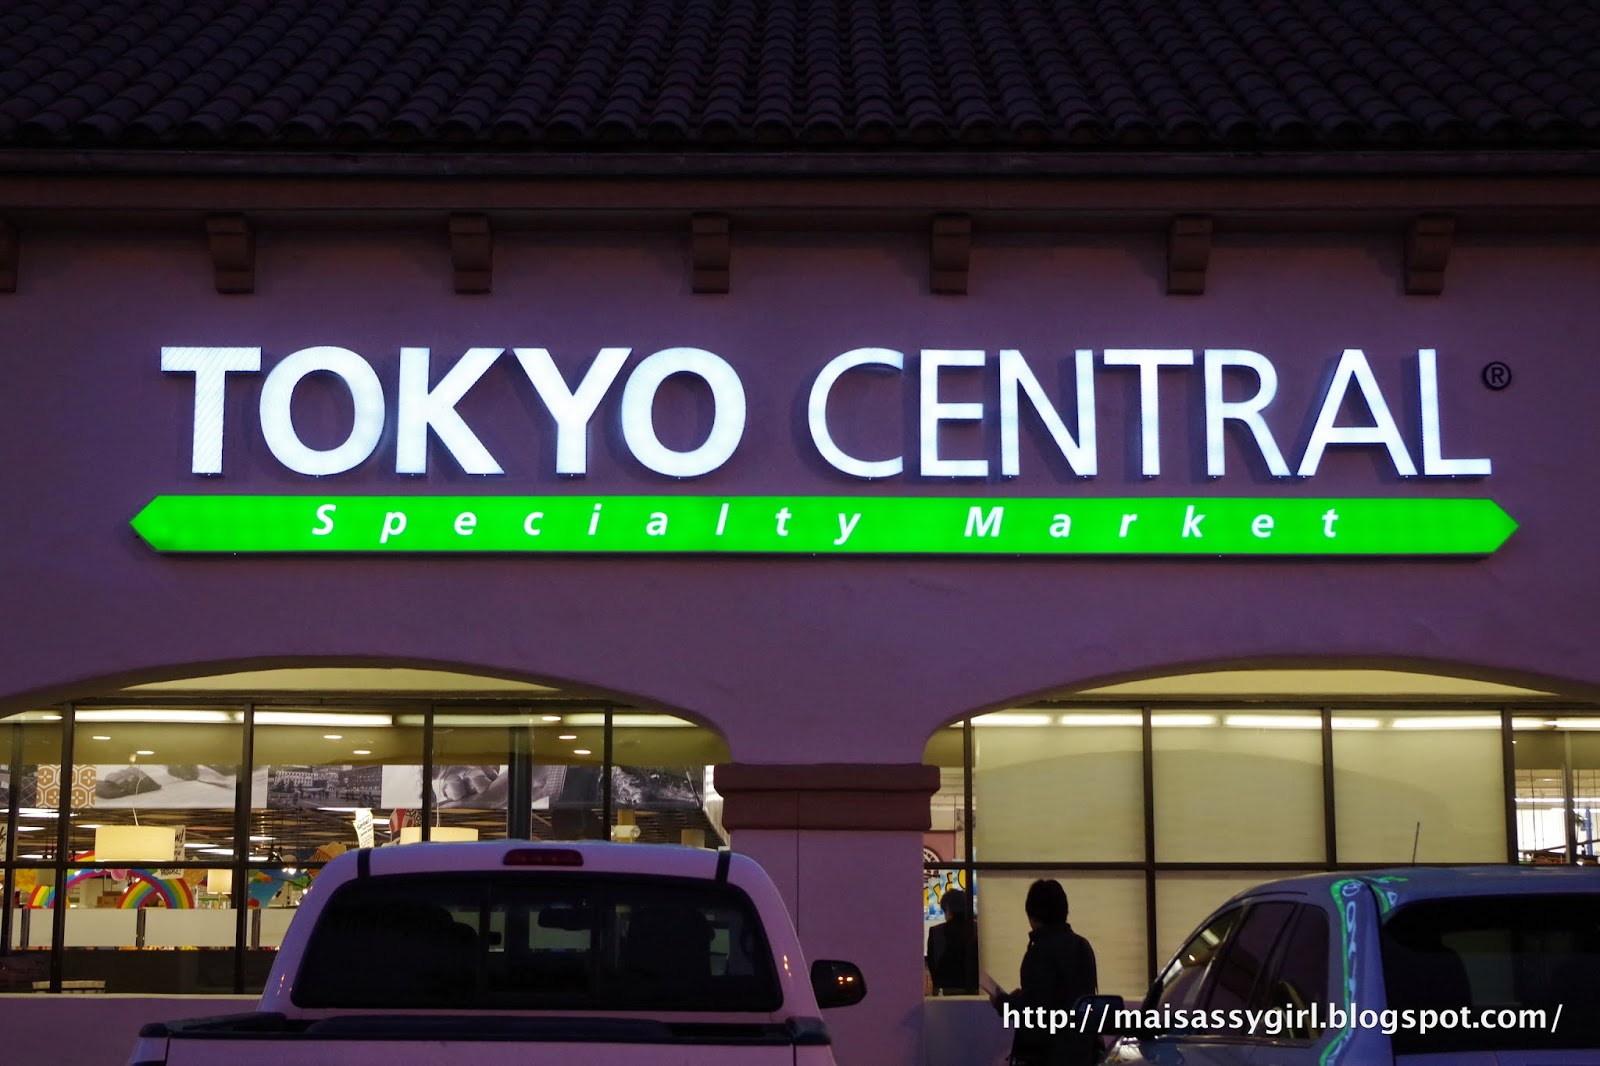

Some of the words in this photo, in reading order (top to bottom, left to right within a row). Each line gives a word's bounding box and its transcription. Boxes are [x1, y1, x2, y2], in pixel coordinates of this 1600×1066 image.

[161, 346, 746, 477] TOKYO
[808, 348, 1491, 478] CENTRAL
[312, 503, 862, 545] Specialty
[964, 505, 1339, 538] Market
